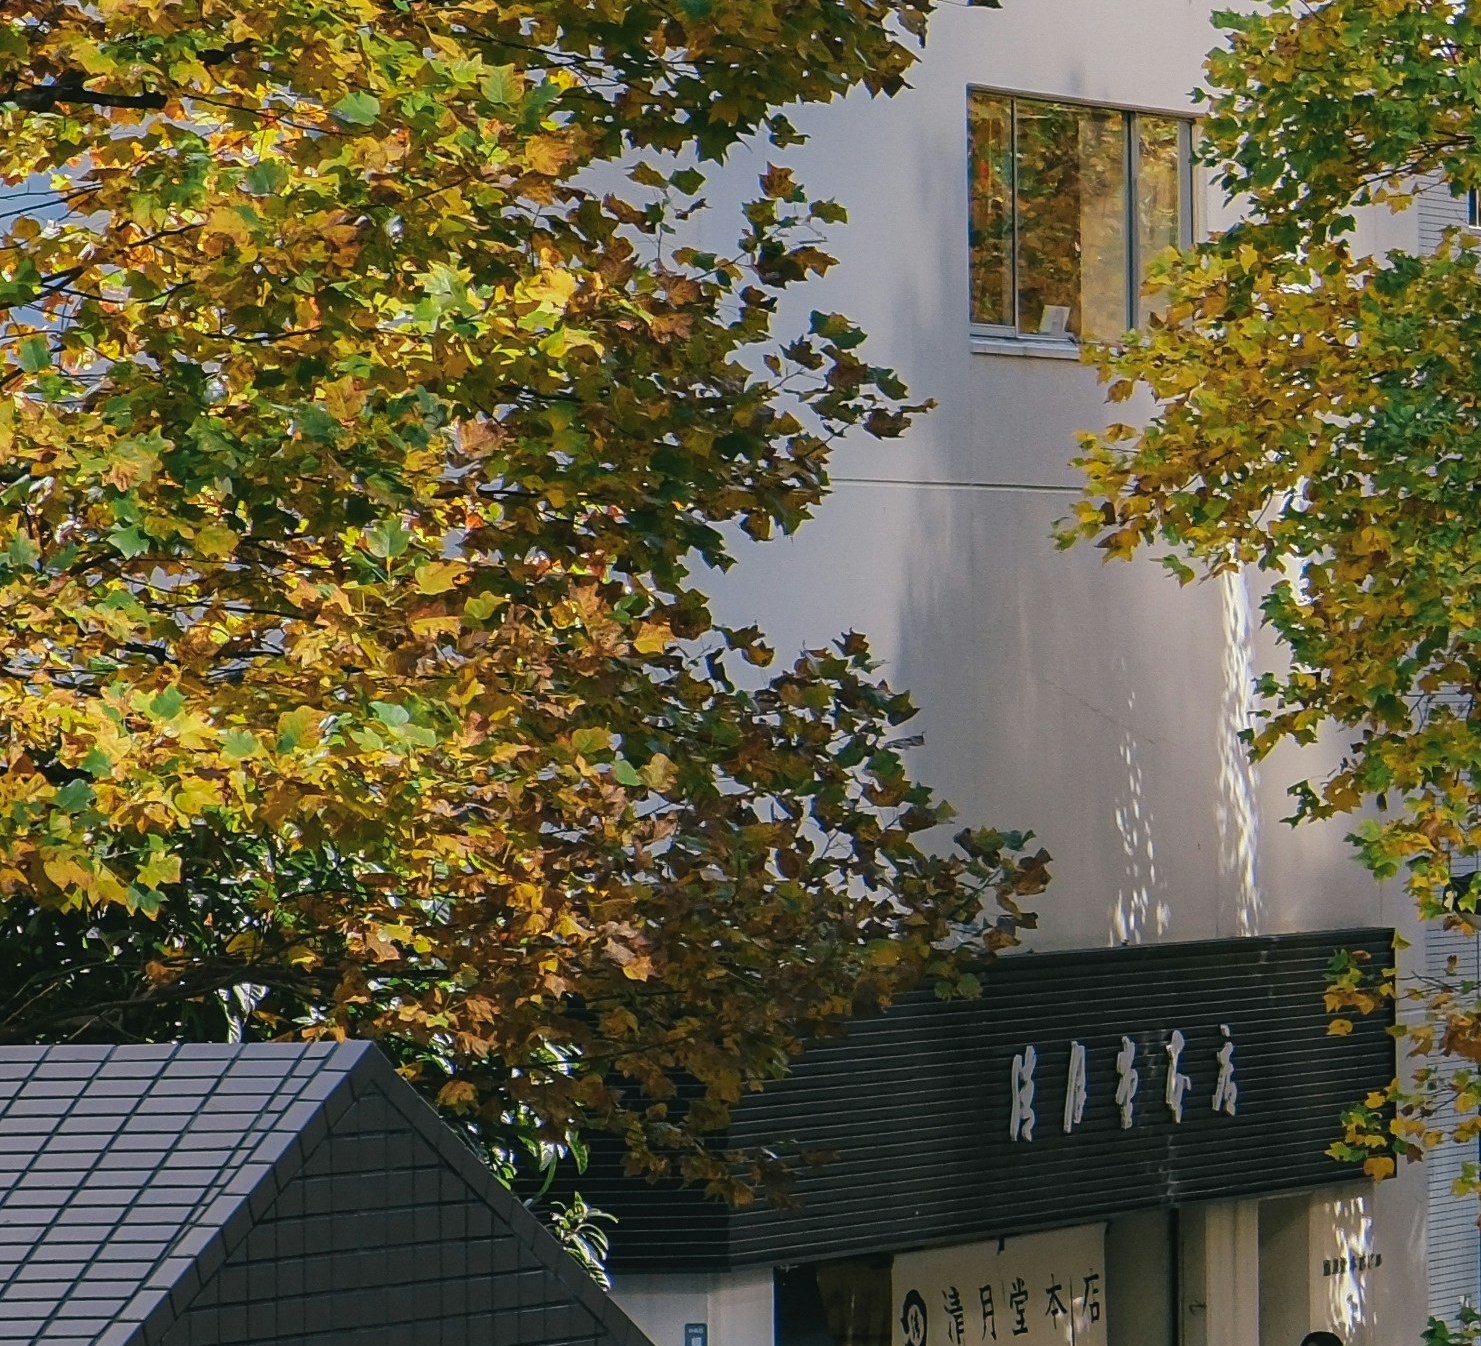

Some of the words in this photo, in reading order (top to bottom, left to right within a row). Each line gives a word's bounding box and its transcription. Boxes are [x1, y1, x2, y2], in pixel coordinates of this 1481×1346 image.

[941, 1267, 1100, 1346] 清月堂本店
